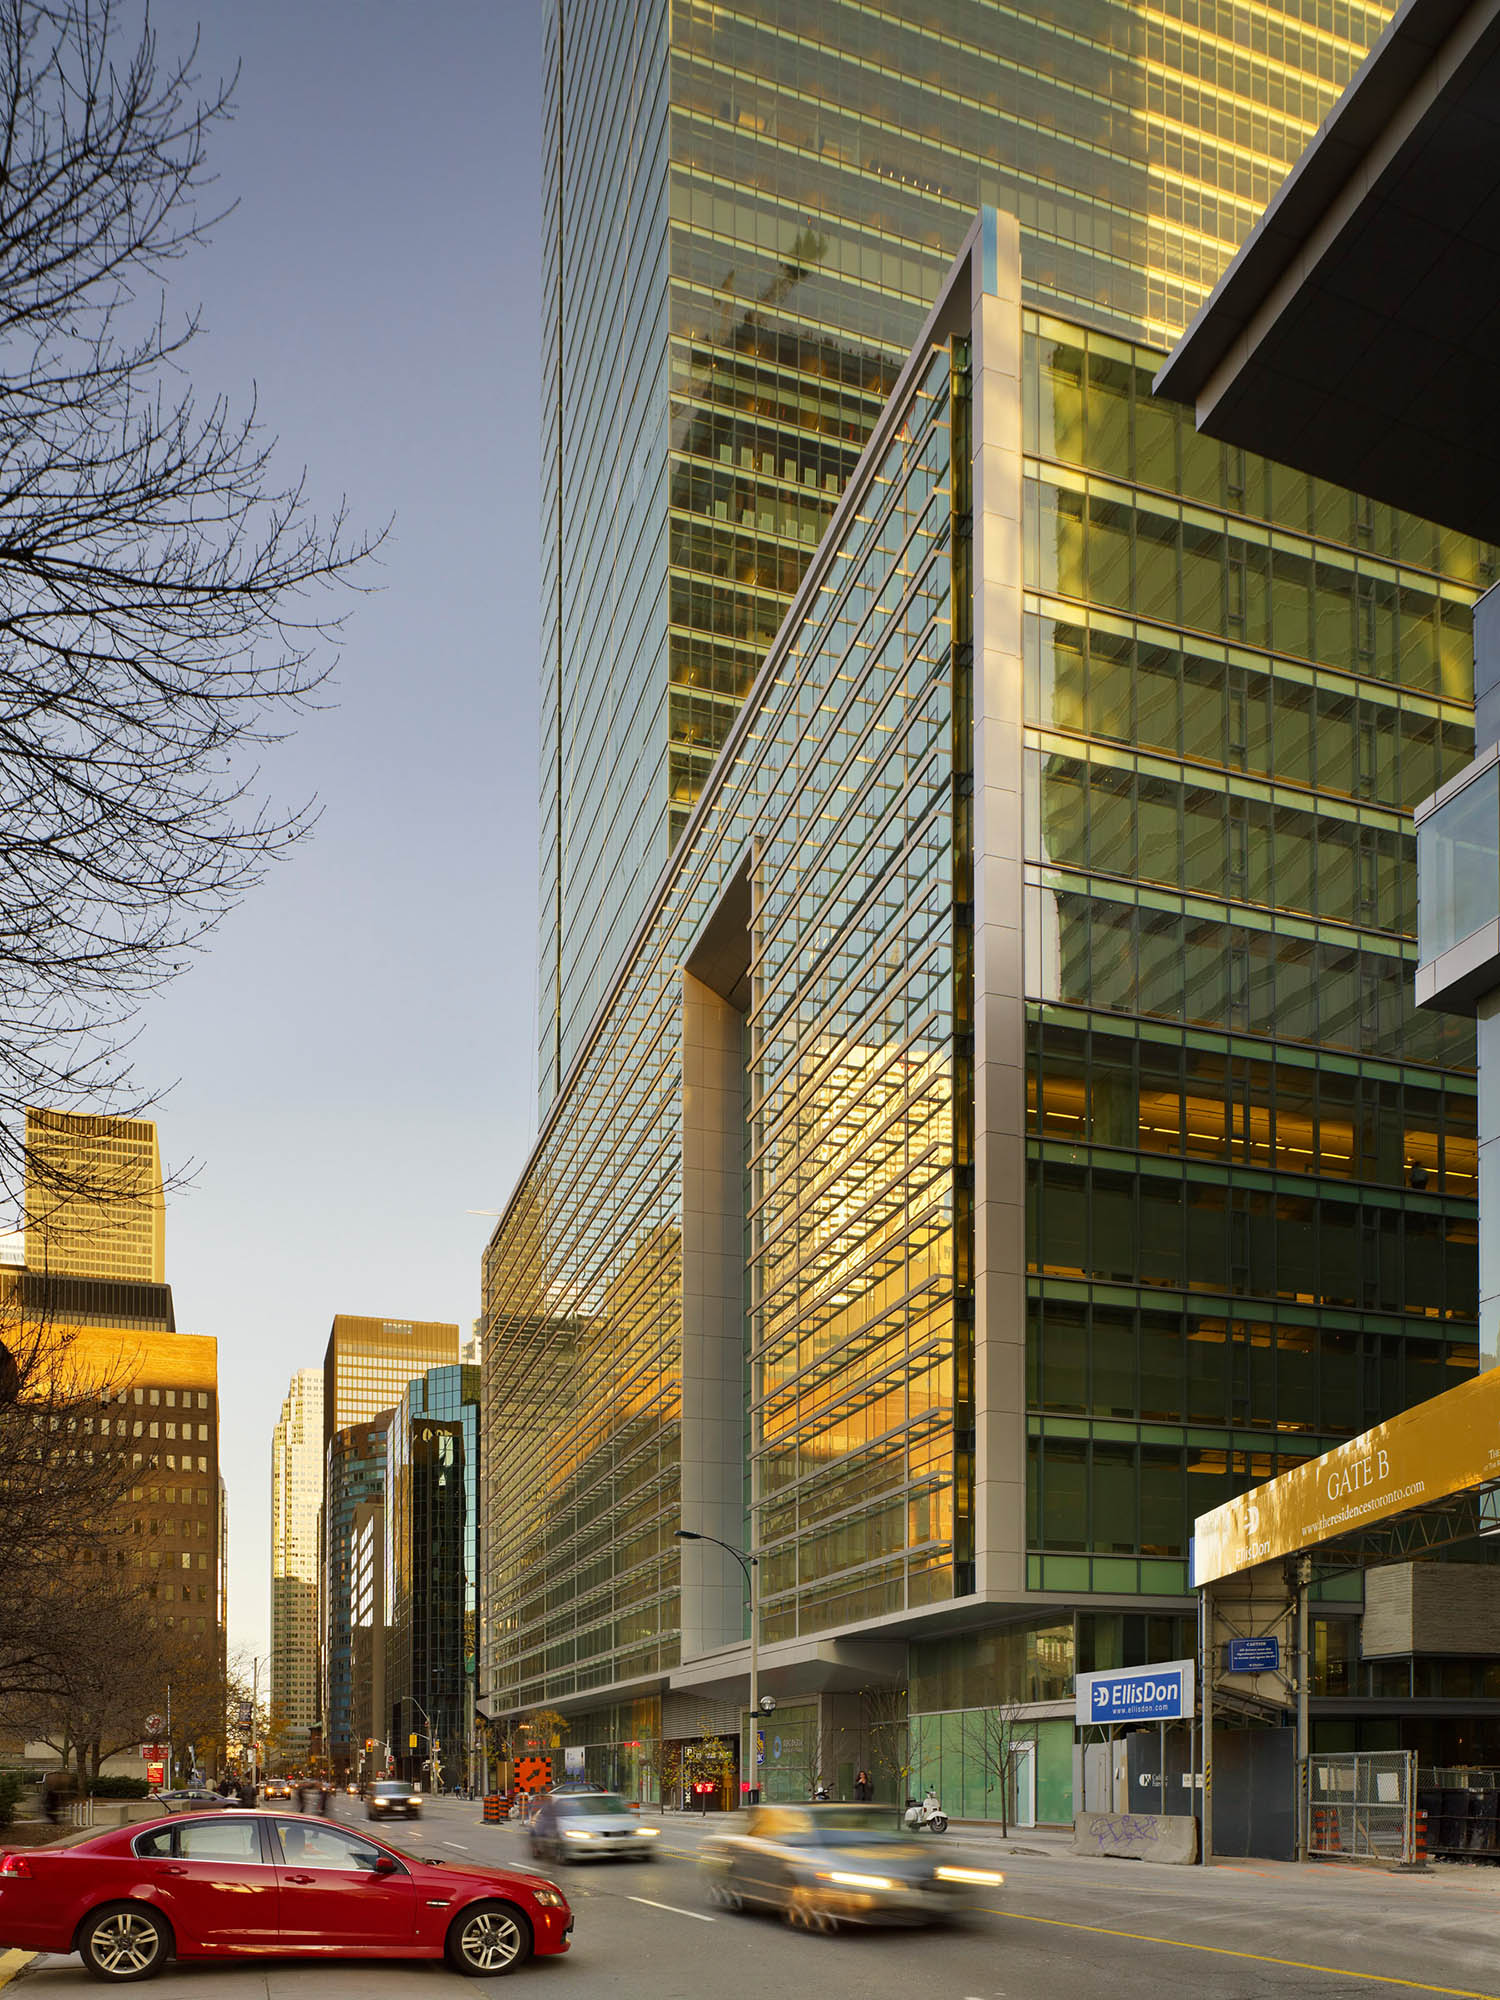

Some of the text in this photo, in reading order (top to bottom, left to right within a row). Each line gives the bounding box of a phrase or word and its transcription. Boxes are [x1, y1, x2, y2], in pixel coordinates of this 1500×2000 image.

[1327, 1449, 1390, 1501] GATE B
[1301, 1480, 1425, 1537] www.theresidencestoronto.com
[1112, 1681, 1178, 1706] EllisDon
[1112, 1704, 1168, 1715] www.ellisdon.com
